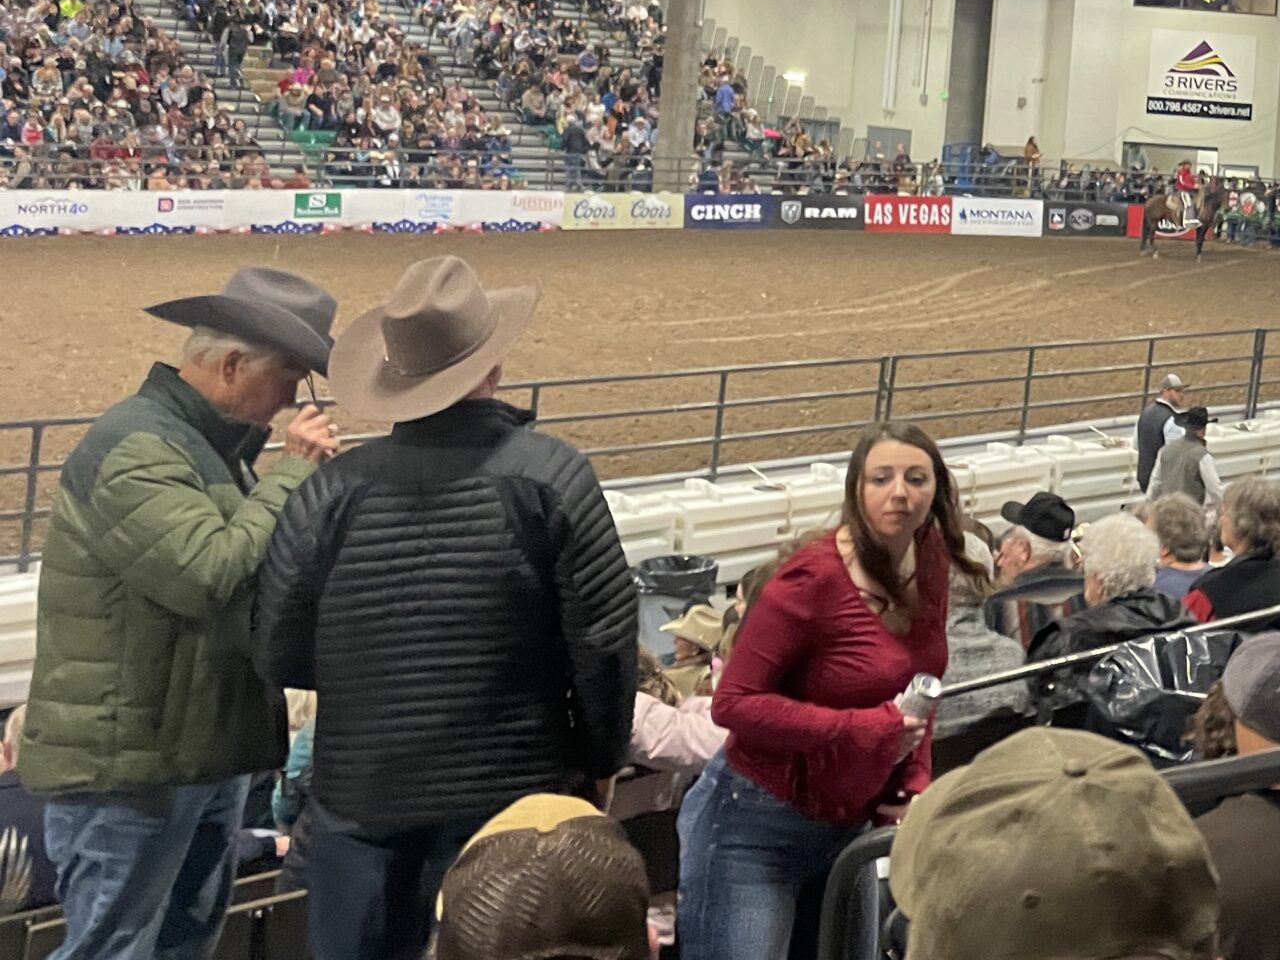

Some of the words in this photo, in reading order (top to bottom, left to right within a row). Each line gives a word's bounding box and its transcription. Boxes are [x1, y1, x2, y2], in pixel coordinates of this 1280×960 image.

[1164, 76, 1174, 88] 3
[1178, 77, 1238, 92] RIVERS
[18, 204, 67, 215] NORTH
[69, 203, 88, 215] 40
[573, 198, 616, 219] Coors
[630, 198, 672, 219] Coors
[691, 204, 762, 221] CINCH
[804, 207, 857, 219] RAM
[864, 203, 893, 225] LAS
[898, 203, 950, 226] VEGAS
[969, 208, 1033, 221] MONTANA
